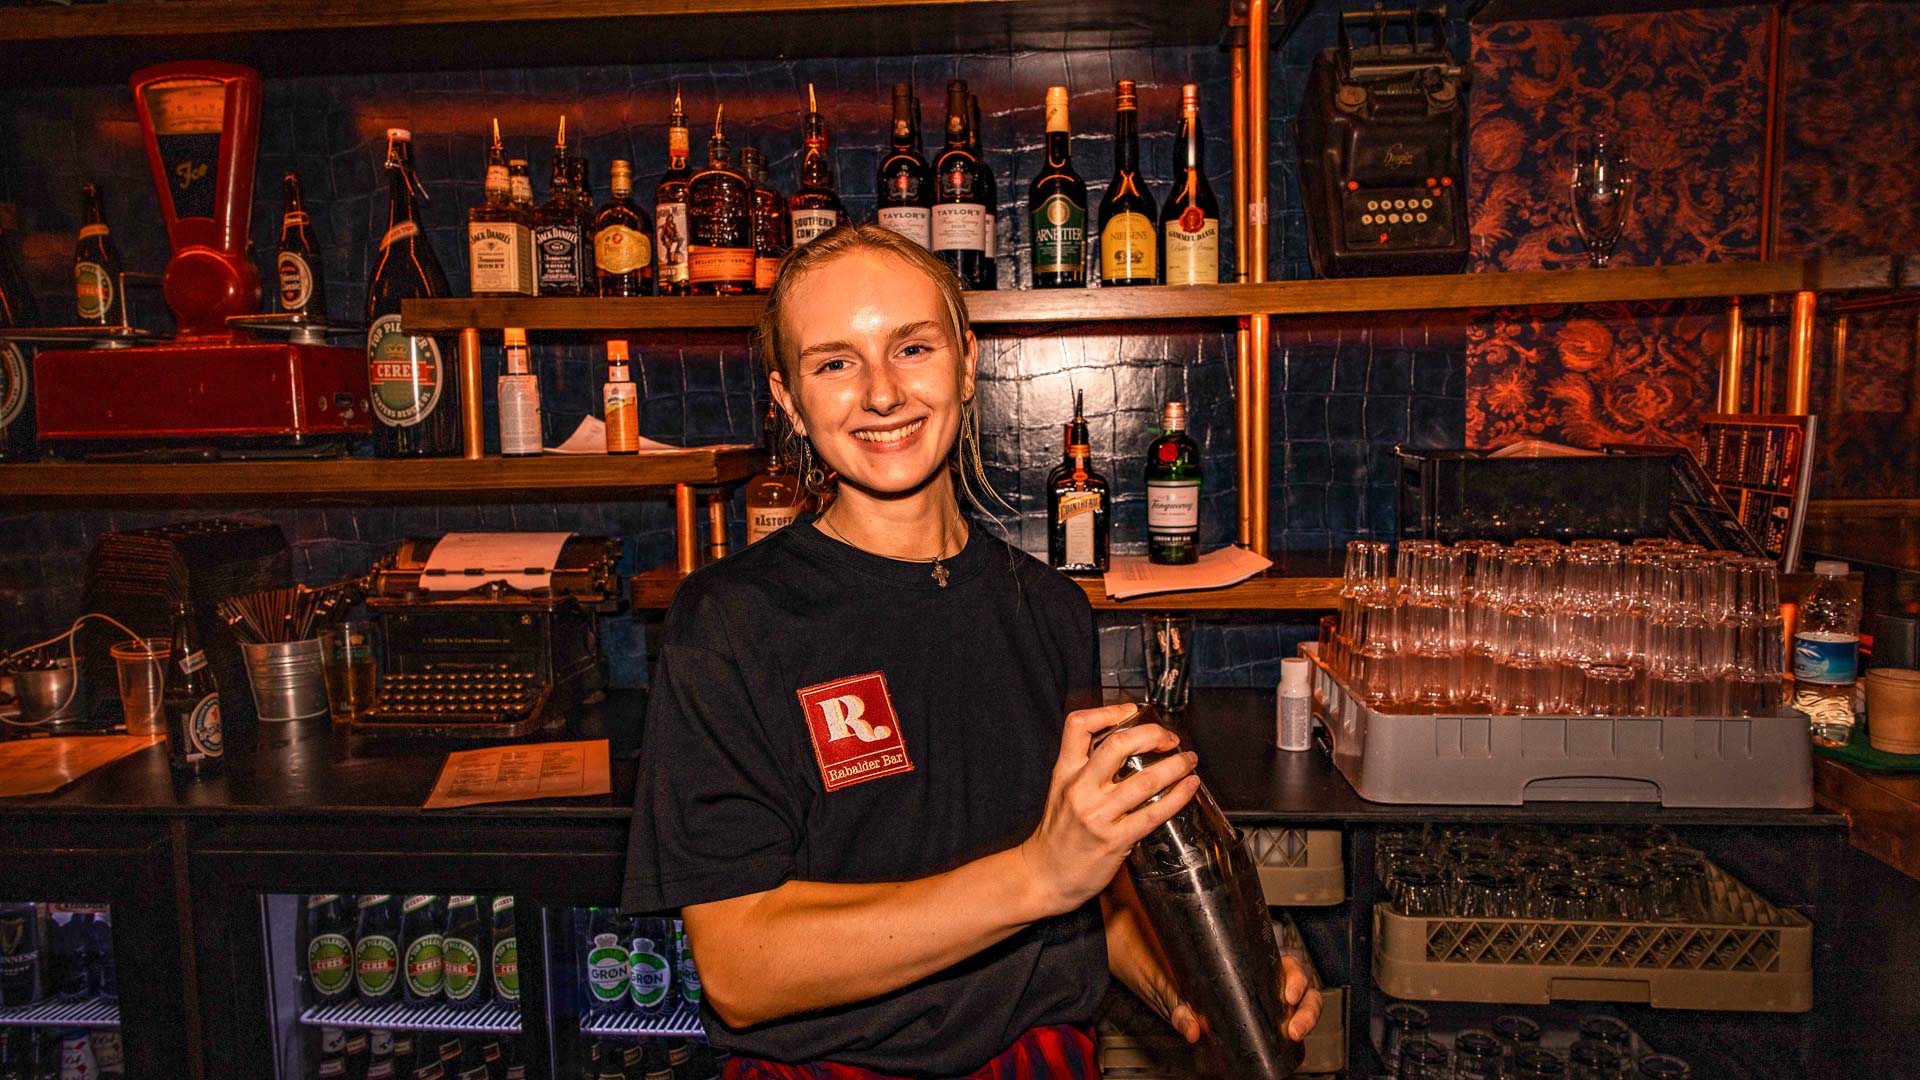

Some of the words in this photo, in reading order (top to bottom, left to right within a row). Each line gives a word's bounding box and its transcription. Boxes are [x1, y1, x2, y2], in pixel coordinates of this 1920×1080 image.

[882, 211, 927, 220] TAYLOR'S
[936, 208, 981, 217] TAYLOR'S
[795, 216, 833, 228] SOUTHERN
[470, 231, 486, 245] JACK
[537, 231, 553, 244] JACK
[1036, 227, 1084, 242] ARNBTTER
[1110, 231, 1148, 241] NIELENS
[371, 328, 383, 348] TOP
[1060, 497, 1098, 518] COINTREAU
[1152, 499, 1193, 511] Tanqueray
[828, 757, 881, 782] Rabalder
[882, 752, 903, 767] Bar
[316, 957, 343, 969] CERES
[361, 961, 388, 970] CERES
[501, 964, 518, 973] CER
[591, 965, 627, 979] GRØN
[631, 973, 663, 985] GRØN
